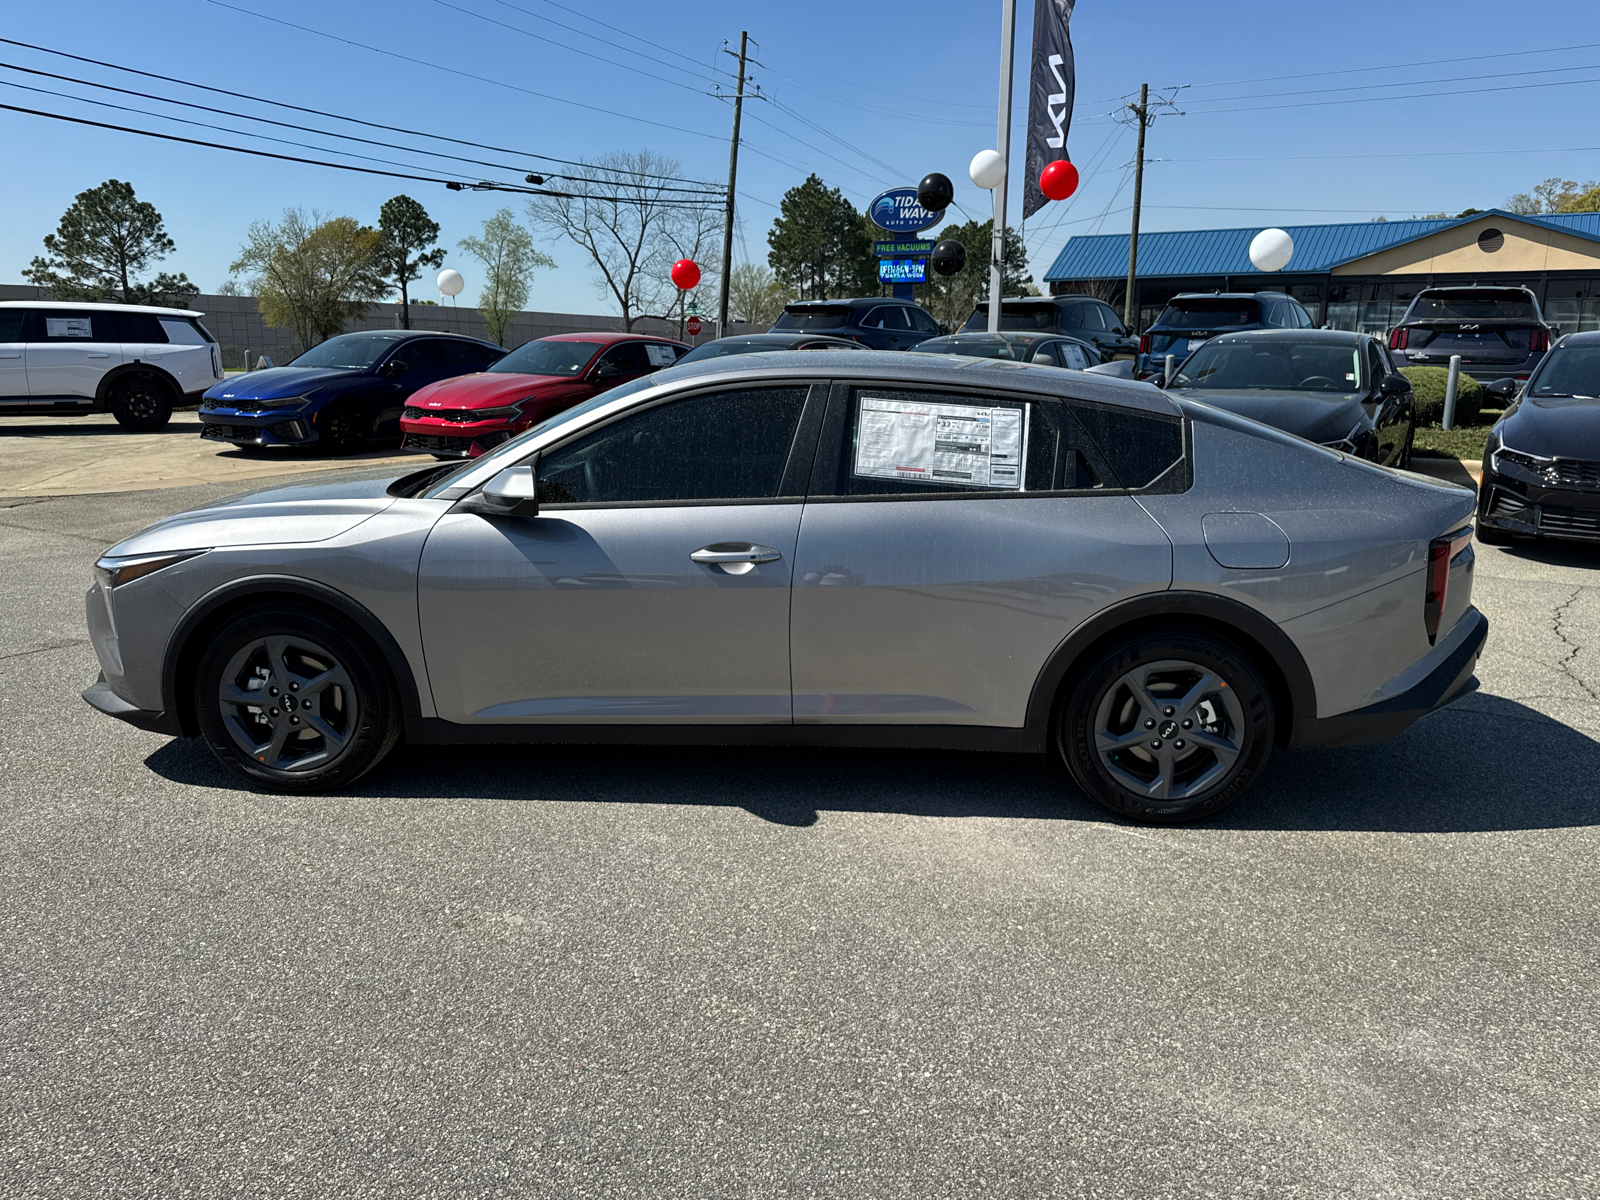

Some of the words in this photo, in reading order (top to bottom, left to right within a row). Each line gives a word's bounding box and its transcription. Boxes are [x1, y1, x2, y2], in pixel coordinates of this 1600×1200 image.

[1045, 53, 1067, 149] KIA
[894, 196, 922, 208] TIDA
[899, 207, 934, 219] WAVE
[876, 244, 895, 252] FREE
[896, 243, 931, 252] VACUUMS
[687, 322, 700, 330] STOP
[284, 694, 293, 712] KIA
[1161, 722, 1176, 738] KIA
[1202, 767, 1252, 810] KUMHO
